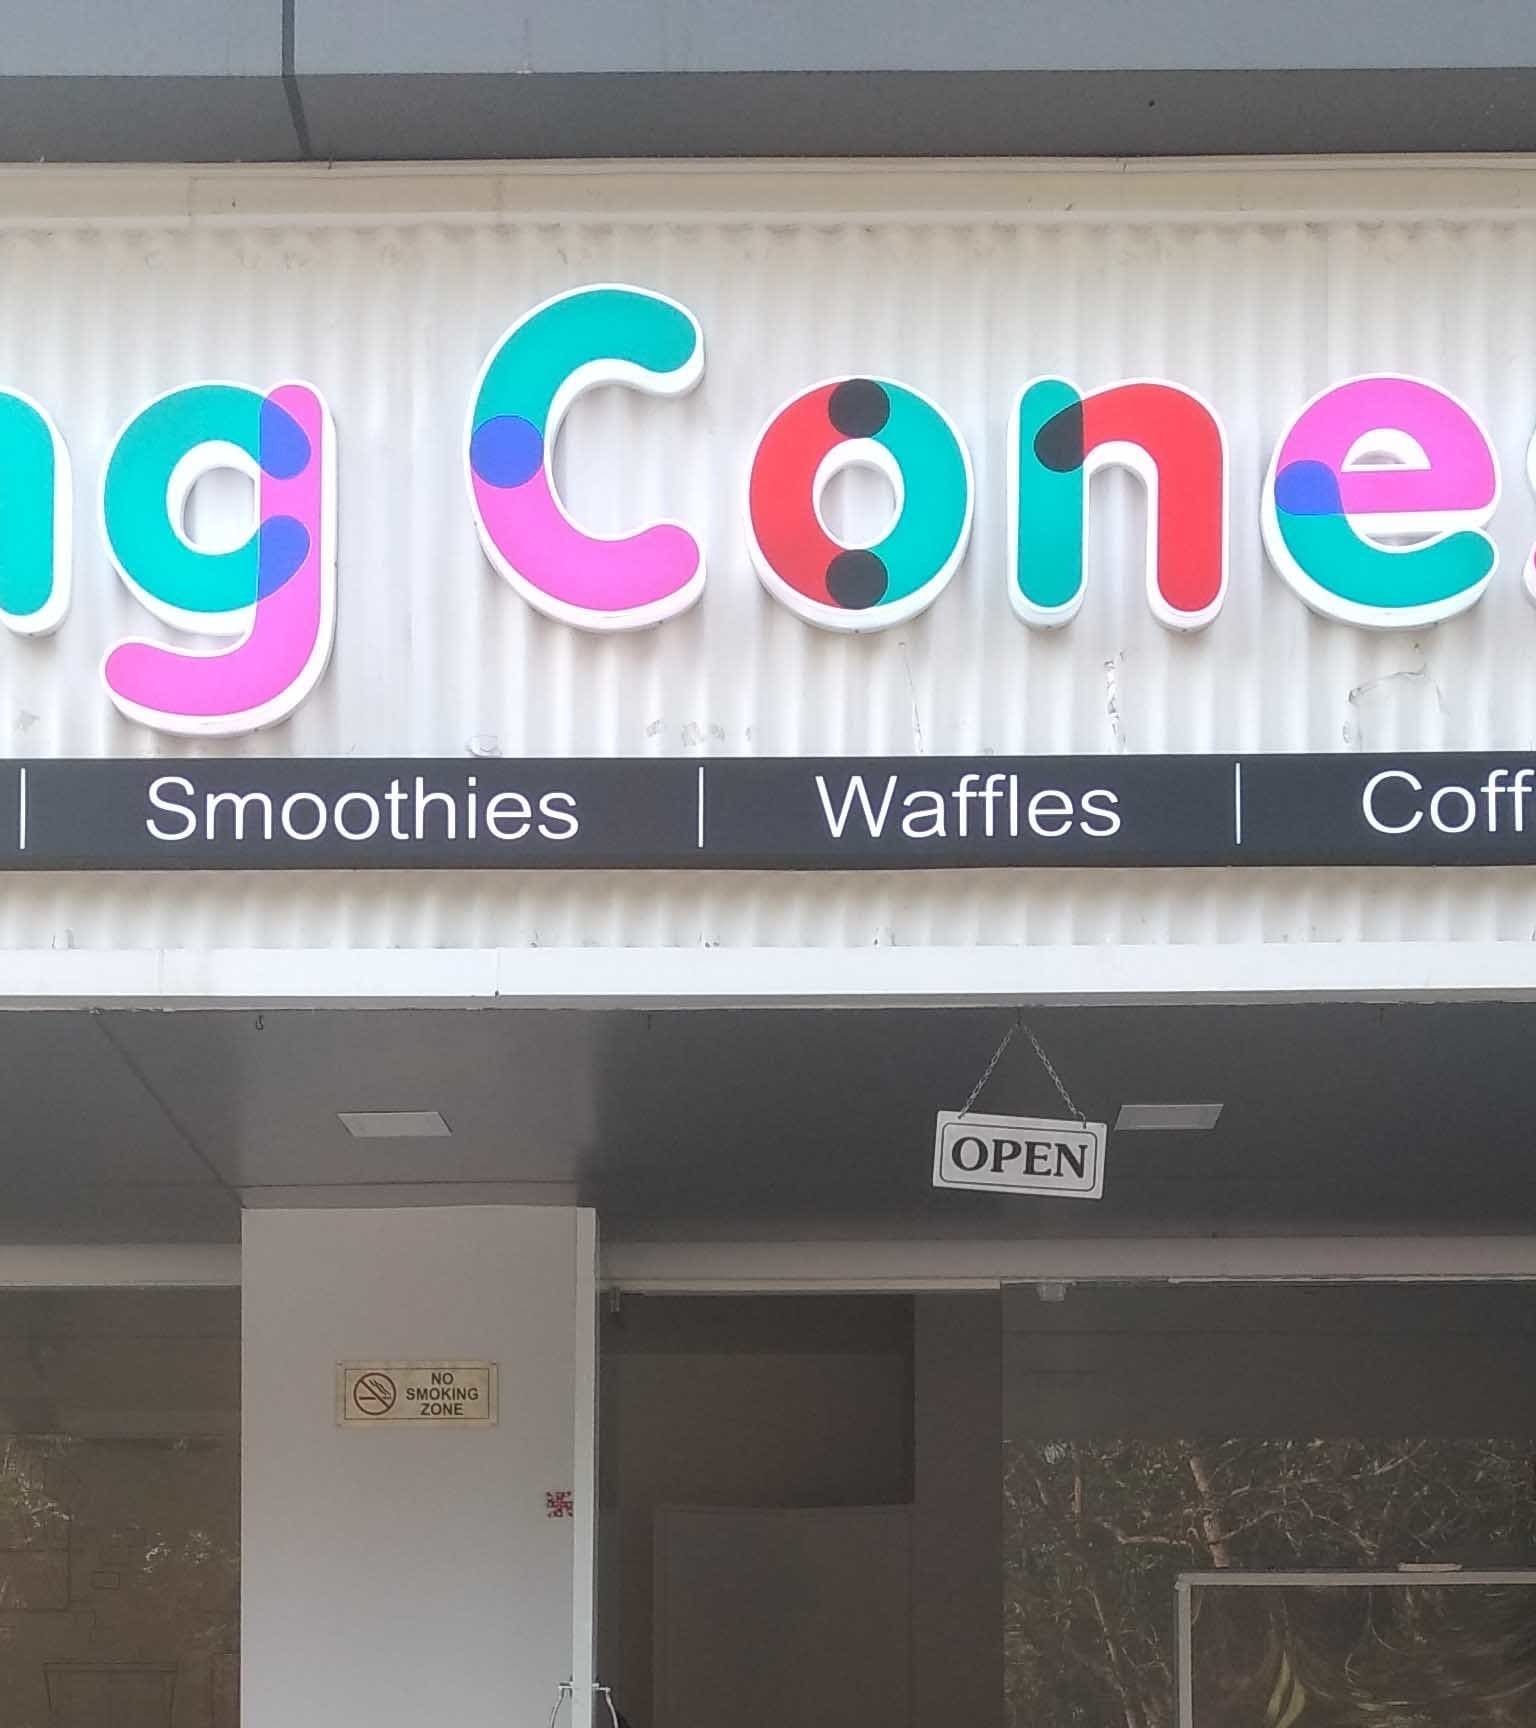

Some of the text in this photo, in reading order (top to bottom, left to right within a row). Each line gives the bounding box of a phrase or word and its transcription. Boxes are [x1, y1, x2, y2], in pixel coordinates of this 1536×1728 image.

[145, 774, 579, 842] Smoothies
[815, 773, 1121, 838] Waffles
[951, 1136, 1089, 1179] OPEN
[431, 1372, 454, 1386] NO
[405, 1387, 479, 1401] SMOKING
[420, 1403, 465, 1416] ZONE
